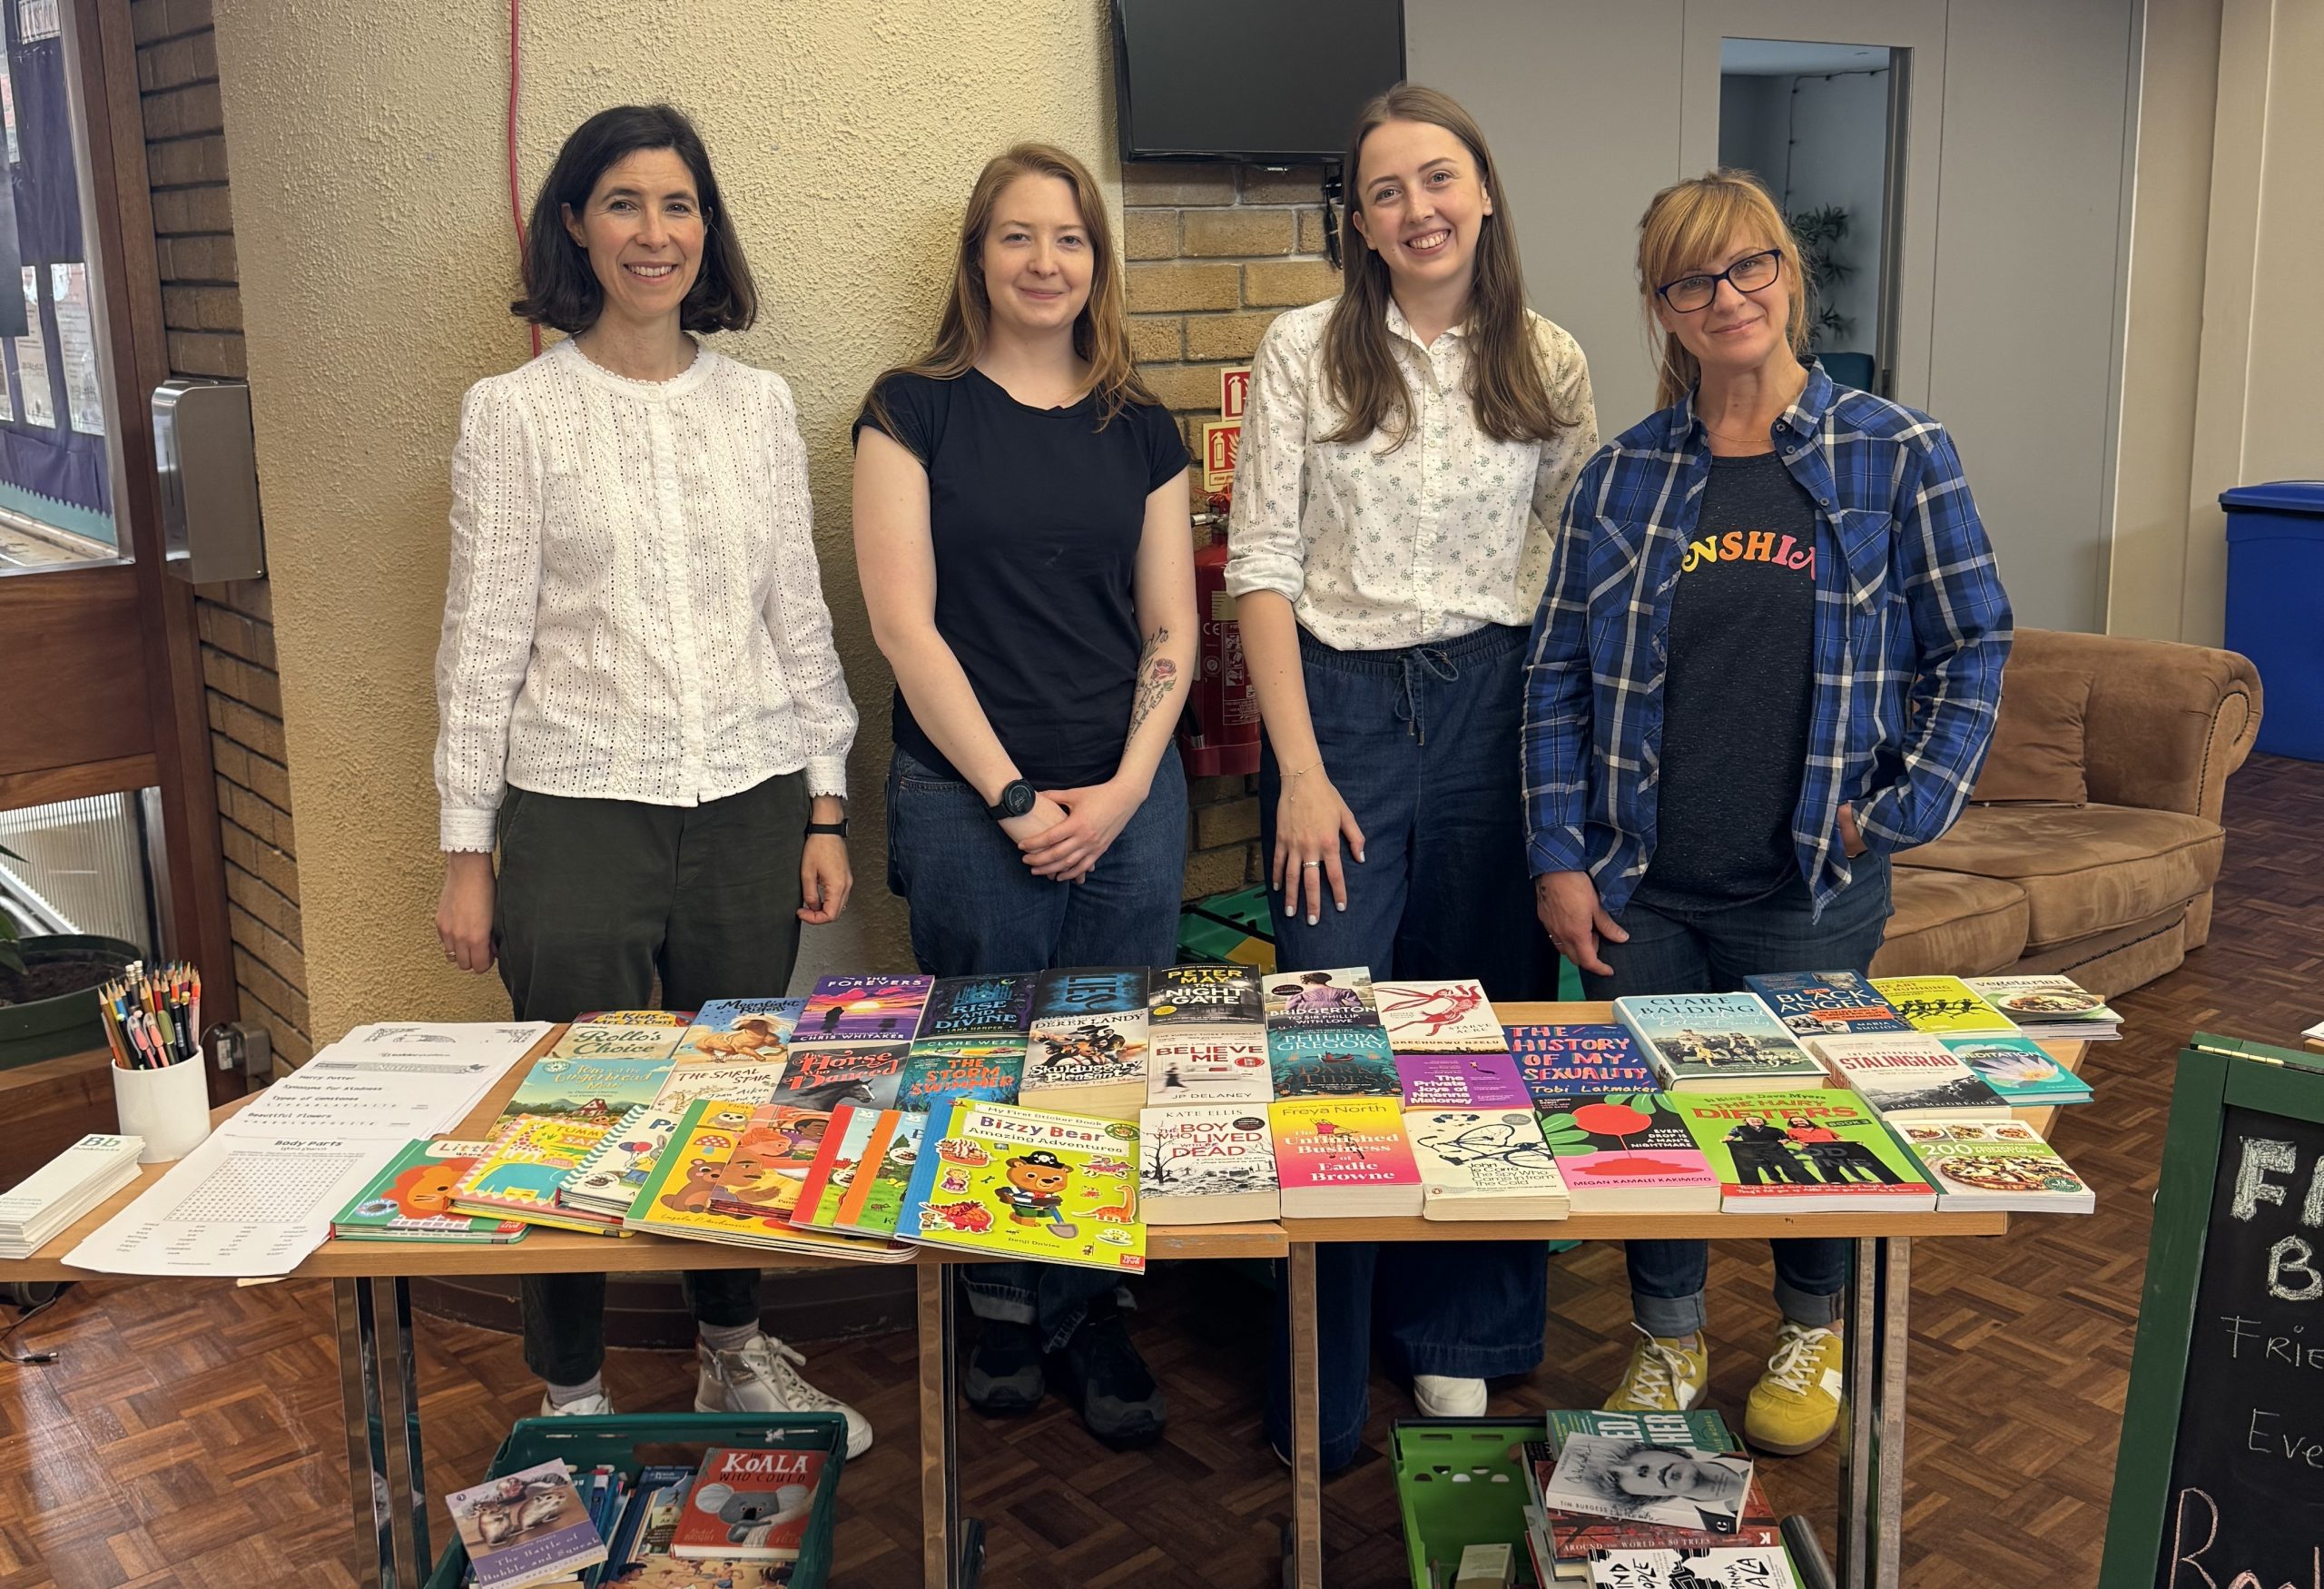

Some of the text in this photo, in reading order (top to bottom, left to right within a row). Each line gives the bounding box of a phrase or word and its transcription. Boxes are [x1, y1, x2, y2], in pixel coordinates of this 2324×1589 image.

[1168, 970, 1243, 979] PETER
[1166, 988, 1245, 998] NIGHT
[1776, 990, 1870, 1003] BLACK
[717, 1000, 799, 1011] Moonlight
[1171, 996, 1240, 1004] GATE
[1650, 997, 1732, 1005] CLARE
[1780, 998, 1889, 1012] ANGELS
[951, 1001, 1007, 1014] RISE
[1270, 1006, 1377, 1016] BRIDGERTON
[1640, 1005, 1756, 1014] BALDING
[960, 1010, 994, 1019] AND
[935, 1014, 1017, 1029] DIVINE
[1036, 1013, 1145, 1029] DEREK LANDY
[574, 1031, 661, 1042] Rollo's
[1285, 1033, 1380, 1043] PHILIPPA
[1512, 1027, 1570, 1038] THE
[574, 1041, 655, 1054] Choice
[1276, 1041, 1387, 1051] GREGORY
[1512, 1038, 1630, 1051] HISTORY
[1156, 1046, 1264, 1056] BELIEVE
[1956, 1049, 2042, 1059] MEDITATION
[793, 1050, 891, 1071] Horse
[1192, 1054, 1228, 1062] ME
[1523, 1053, 1626, 1066] OF MY
[1838, 1054, 1959, 1070] STALINGRAD
[948, 1059, 985, 1069] THE
[1030, 1061, 1143, 1075] Skulduggery
[679, 1069, 759, 1081] THE SPIRAL
[783, 1060, 898, 1090] Danced
[925, 1067, 1000, 1081] STORM
[1045, 1070, 1125, 1082] Pleasant
[1300, 1065, 1374, 1076] DARK
[1522, 1068, 1648, 1081] SEXUALITY
[733, 1074, 772, 1083] STAIR
[1305, 1075, 1378, 1084] TIDES
[910, 1076, 1014, 1095] SWIMMER
[1533, 1085, 1659, 1094] Tobi Lakmaker
[1283, 1107, 1330, 1116] Freya
[1334, 1105, 1387, 1113] North
[1710, 1100, 1826, 1110] THE HAIRY
[1035, 1113, 1073, 1122] Sticker
[1691, 1106, 1859, 1120] DIETERS
[648, 1119, 675, 1132] Pi
[980, 1116, 1105, 1141] Bizzy Bear
[1181, 1122, 1228, 1132] BOY
[80, 1137, 121, 1148] Bb
[968, 1127, 1122, 1153] Amazing Adventures
[1194, 1132, 1263, 1143] LIVED
[1285, 1133, 1399, 1145] Unfinished
[1173, 1146, 1246, 1158] DEAD
[1298, 1145, 1392, 1154] Business
[1921, 1144, 1973, 1156] 200
[1318, 1162, 1378, 1171] Eadie
[1311, 1172, 1395, 1181] Browne
[1009, 1236, 1029, 1245] Benji
[719, 1473, 805, 1483] WHO COULD
[1576, 1502, 1609, 1513] BURGESS
[1563, 1542, 1603, 1553] AROUND
[1621, 1540, 1655, 1548] WORLD
[496, 1555, 518, 1566] The
[524, 1541, 561, 1557] Battle
[483, 1564, 526, 1582] Bubble
[532, 1554, 552, 1566] and
[556, 1537, 599, 1557] Squeak
